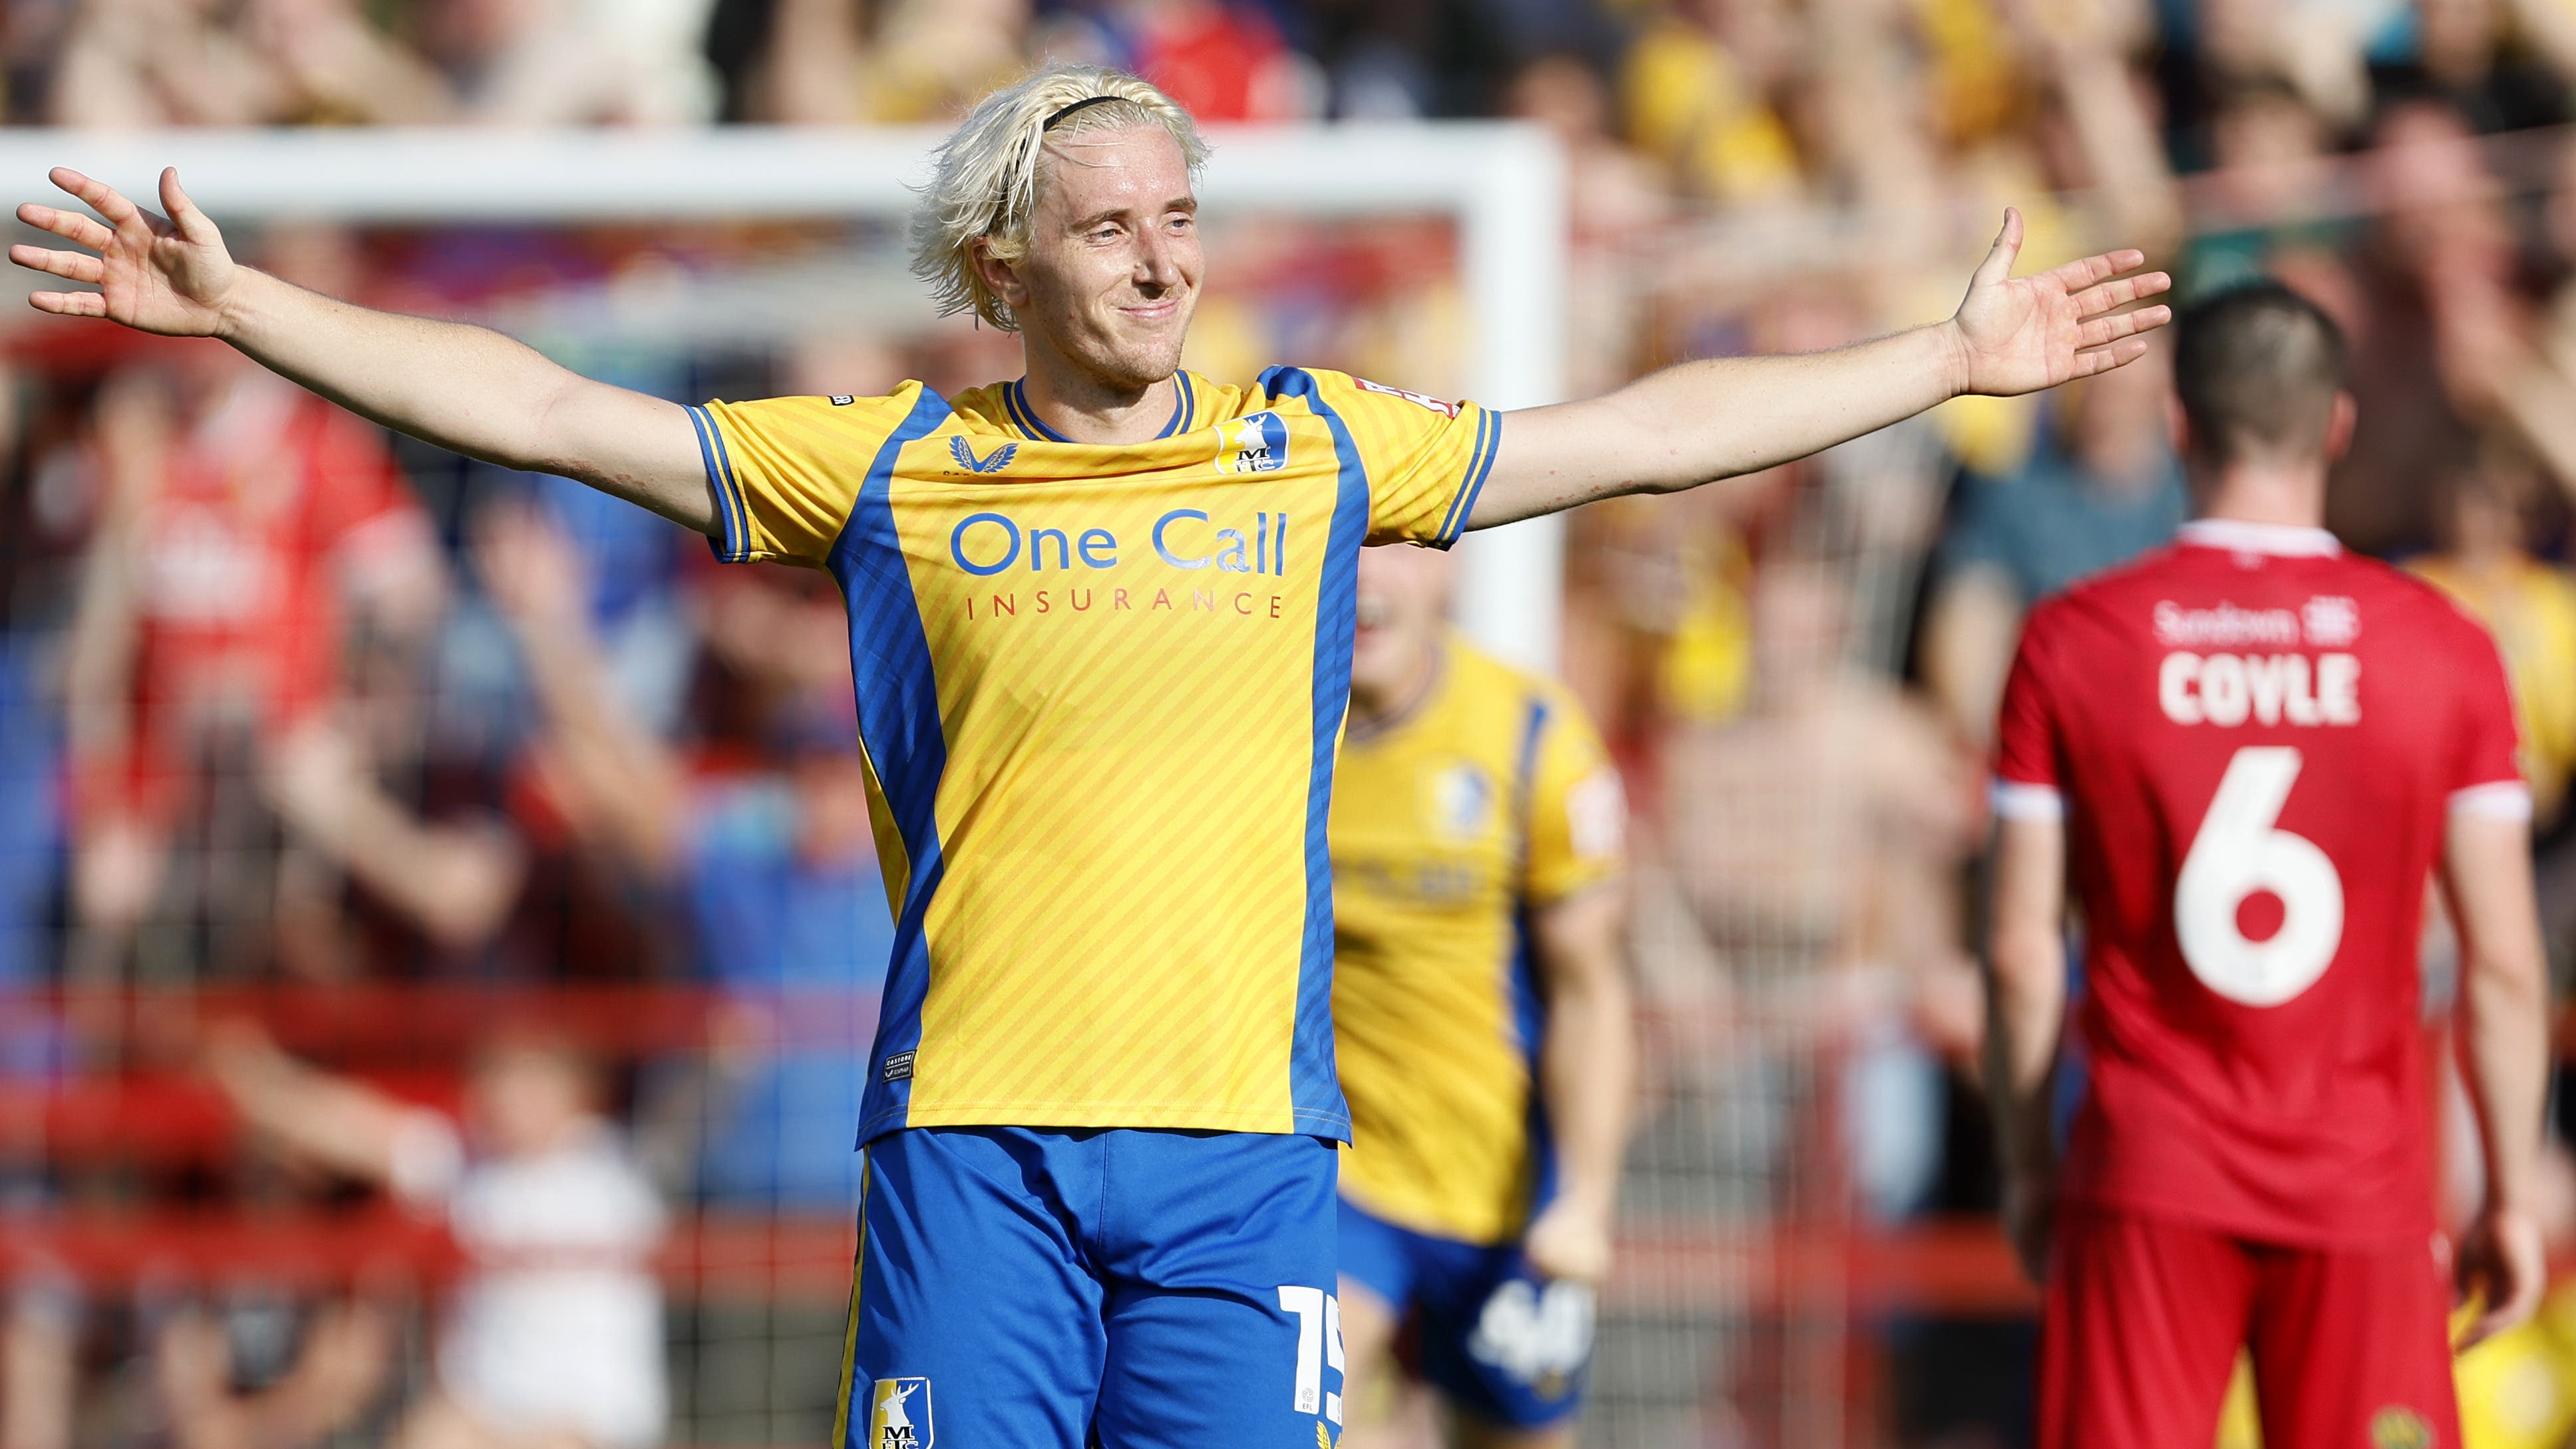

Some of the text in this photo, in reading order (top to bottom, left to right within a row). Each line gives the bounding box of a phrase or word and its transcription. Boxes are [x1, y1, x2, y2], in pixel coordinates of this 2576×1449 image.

[951, 508, 1287, 576] One Call
[967, 587, 1282, 620] INSURANCE
[2159, 651, 2362, 727] COYLE
[2173, 745, 2345, 1008] 6
